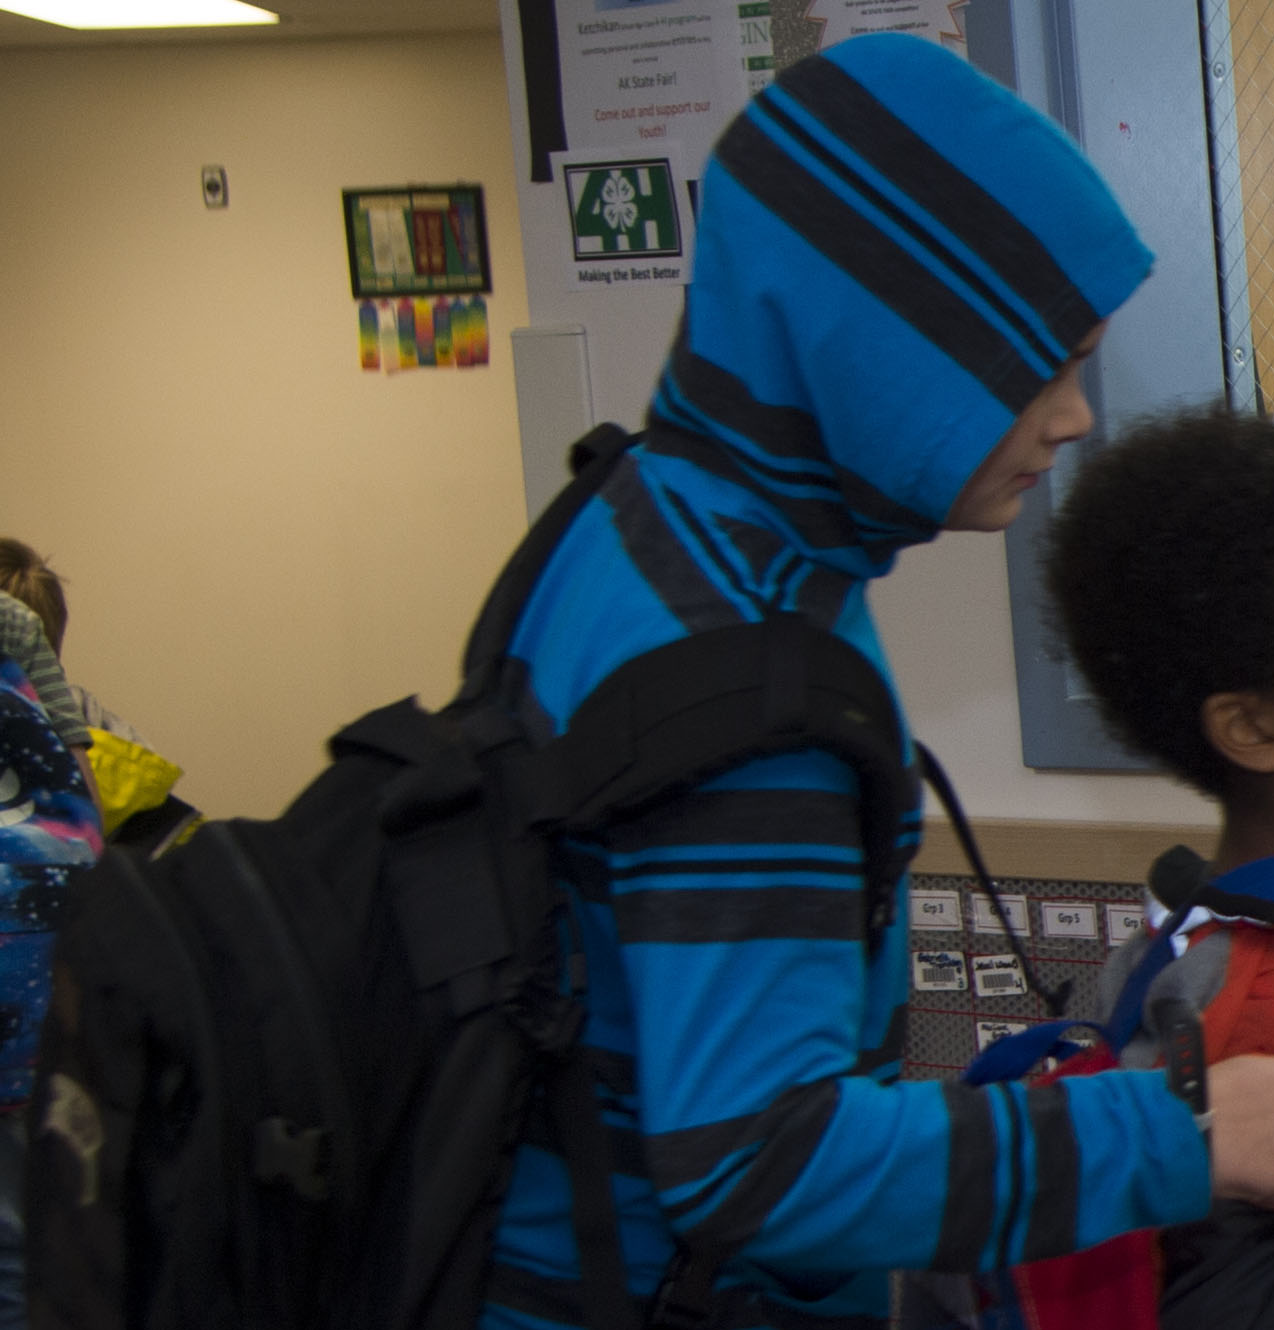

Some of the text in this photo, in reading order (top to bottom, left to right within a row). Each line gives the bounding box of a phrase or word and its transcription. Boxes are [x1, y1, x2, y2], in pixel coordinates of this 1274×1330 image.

[631, 75, 655, 89] State
[595, 101, 711, 121] Come out and support our
[578, 266, 681, 284] Making the Best Better
